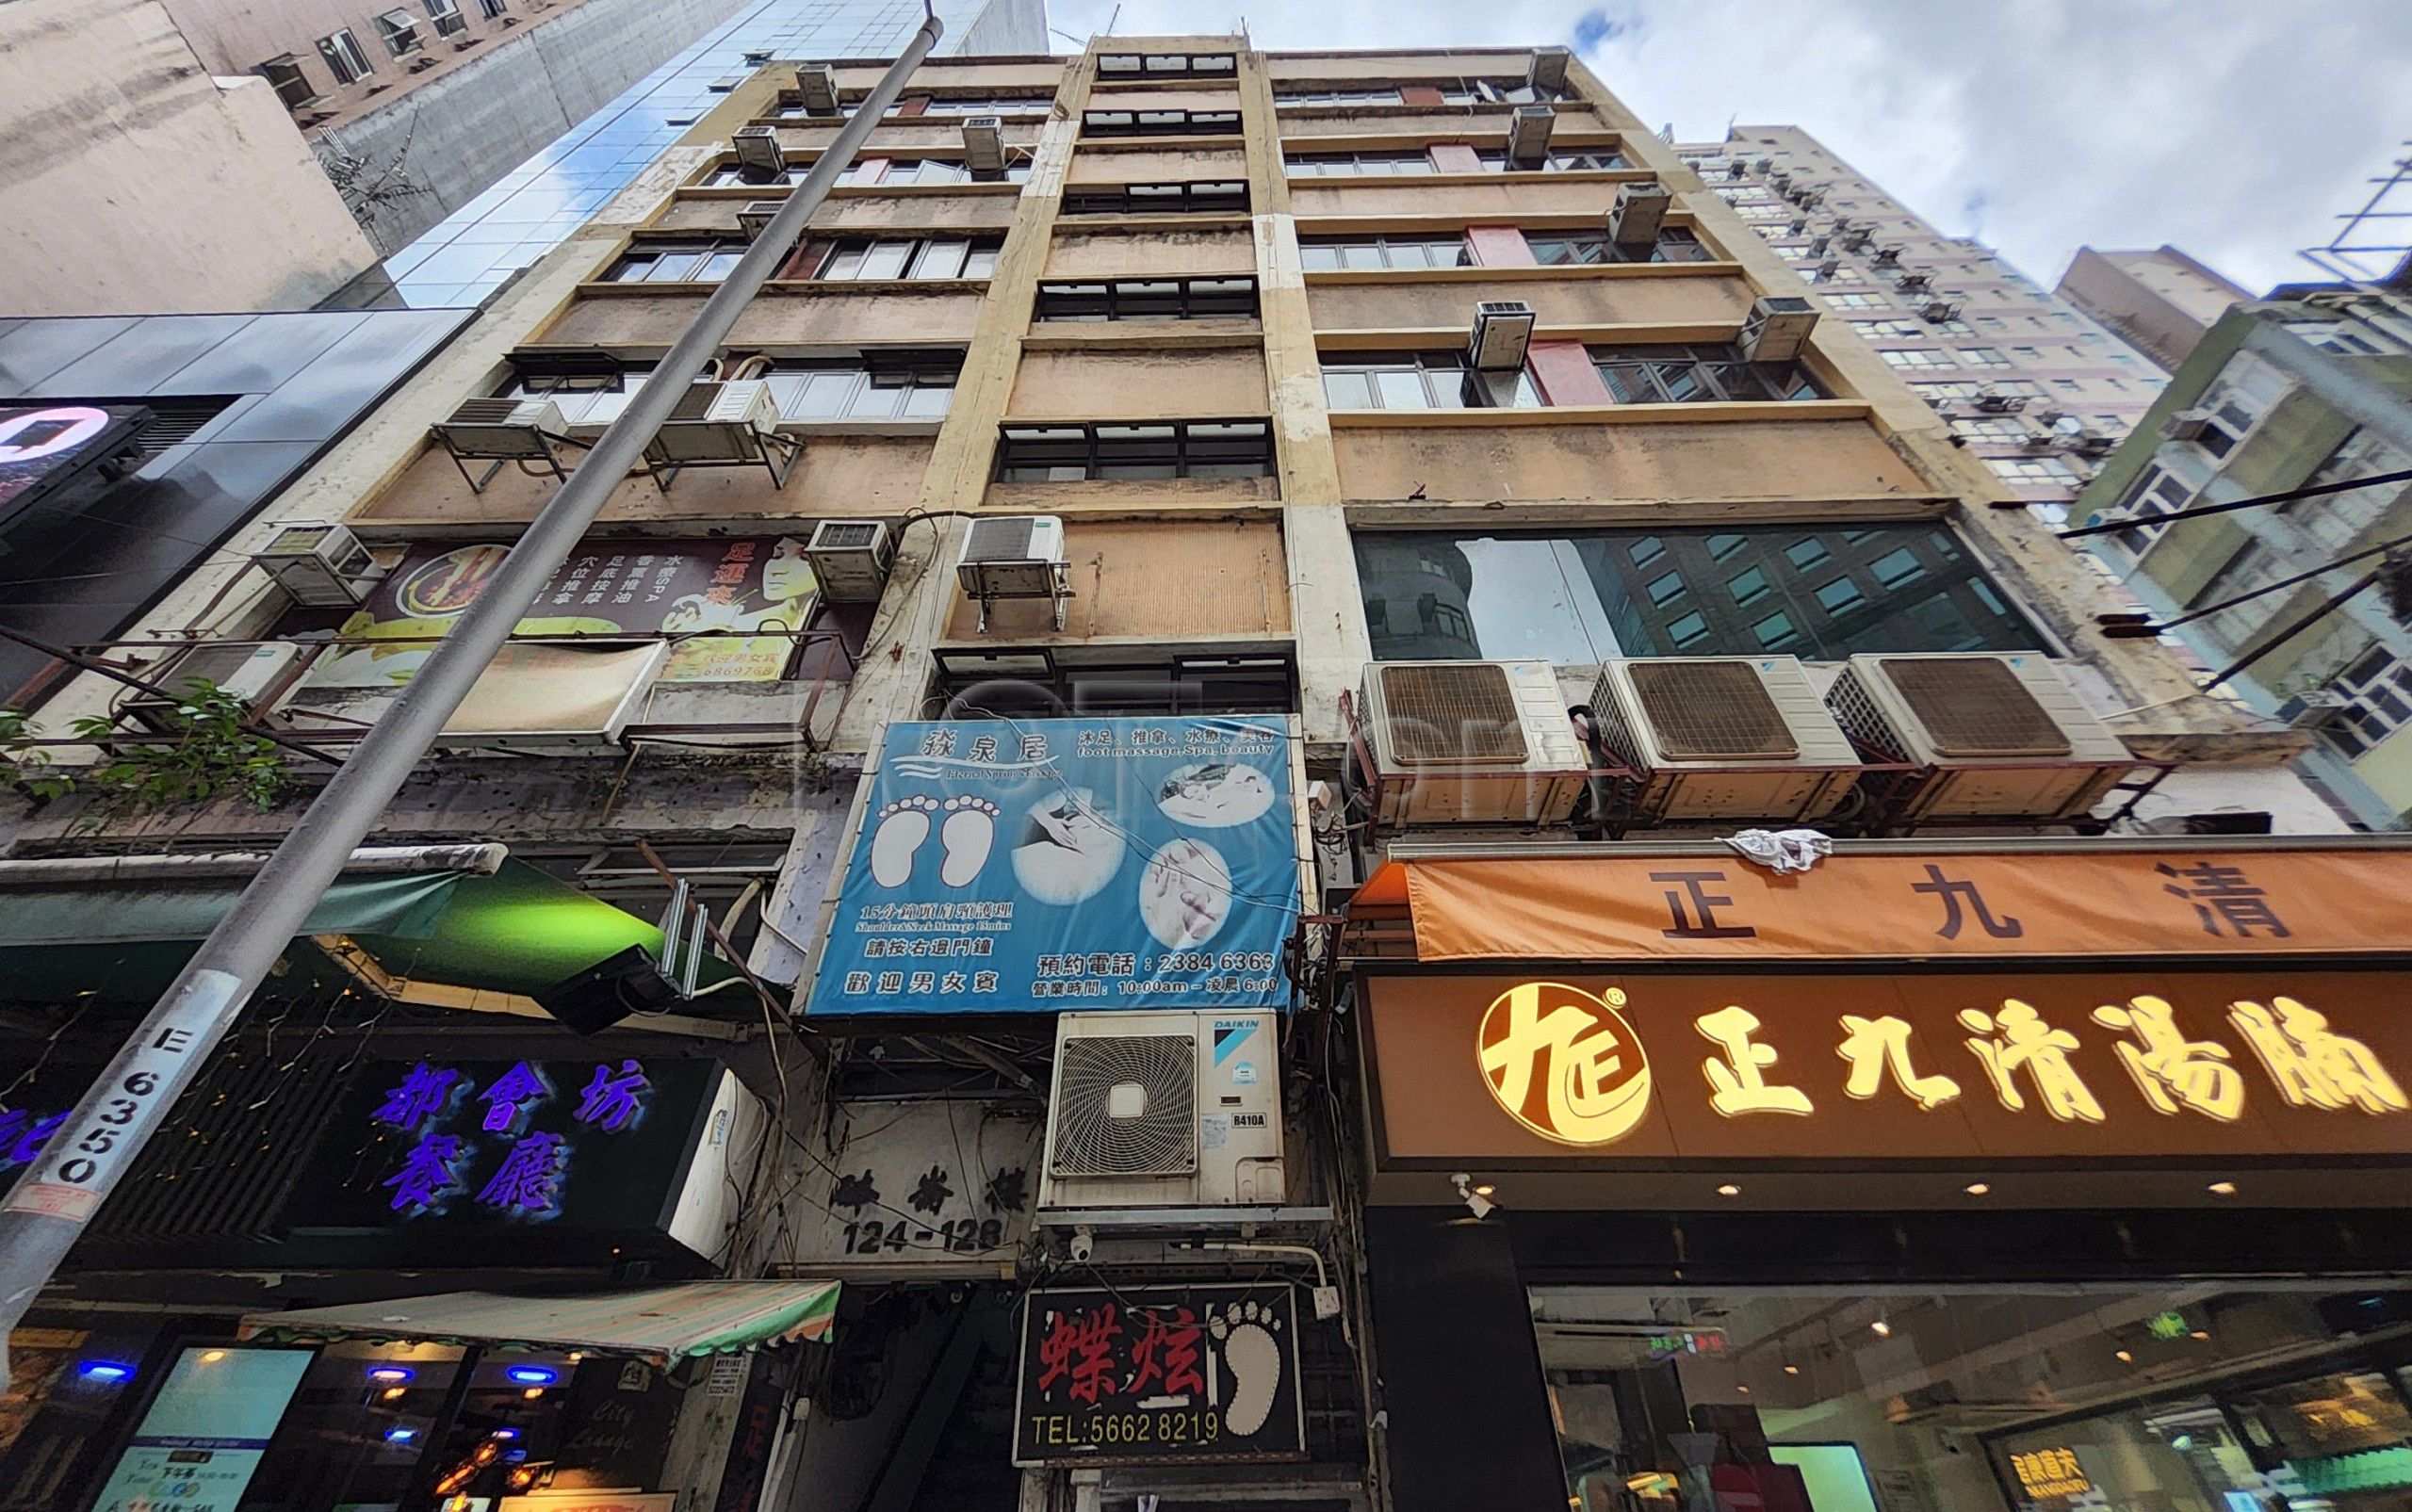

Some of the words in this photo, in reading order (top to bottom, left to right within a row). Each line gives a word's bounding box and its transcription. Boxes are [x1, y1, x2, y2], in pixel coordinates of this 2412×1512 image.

[1078, 745, 1109, 757] foot
[1220, 743, 1275, 756] beauty
[1649, 861, 2291, 939] 正九清
[1219, 952, 1276, 971] 6363
[844, 971, 1000, 994] 歡迎男女賓
[1116, 978, 1188, 995] 10:00am
[369, 1060, 651, 1133] 都會坊
[1233, 1115, 1265, 1127] R410A
[1158, 1412, 1218, 1442] 8219
